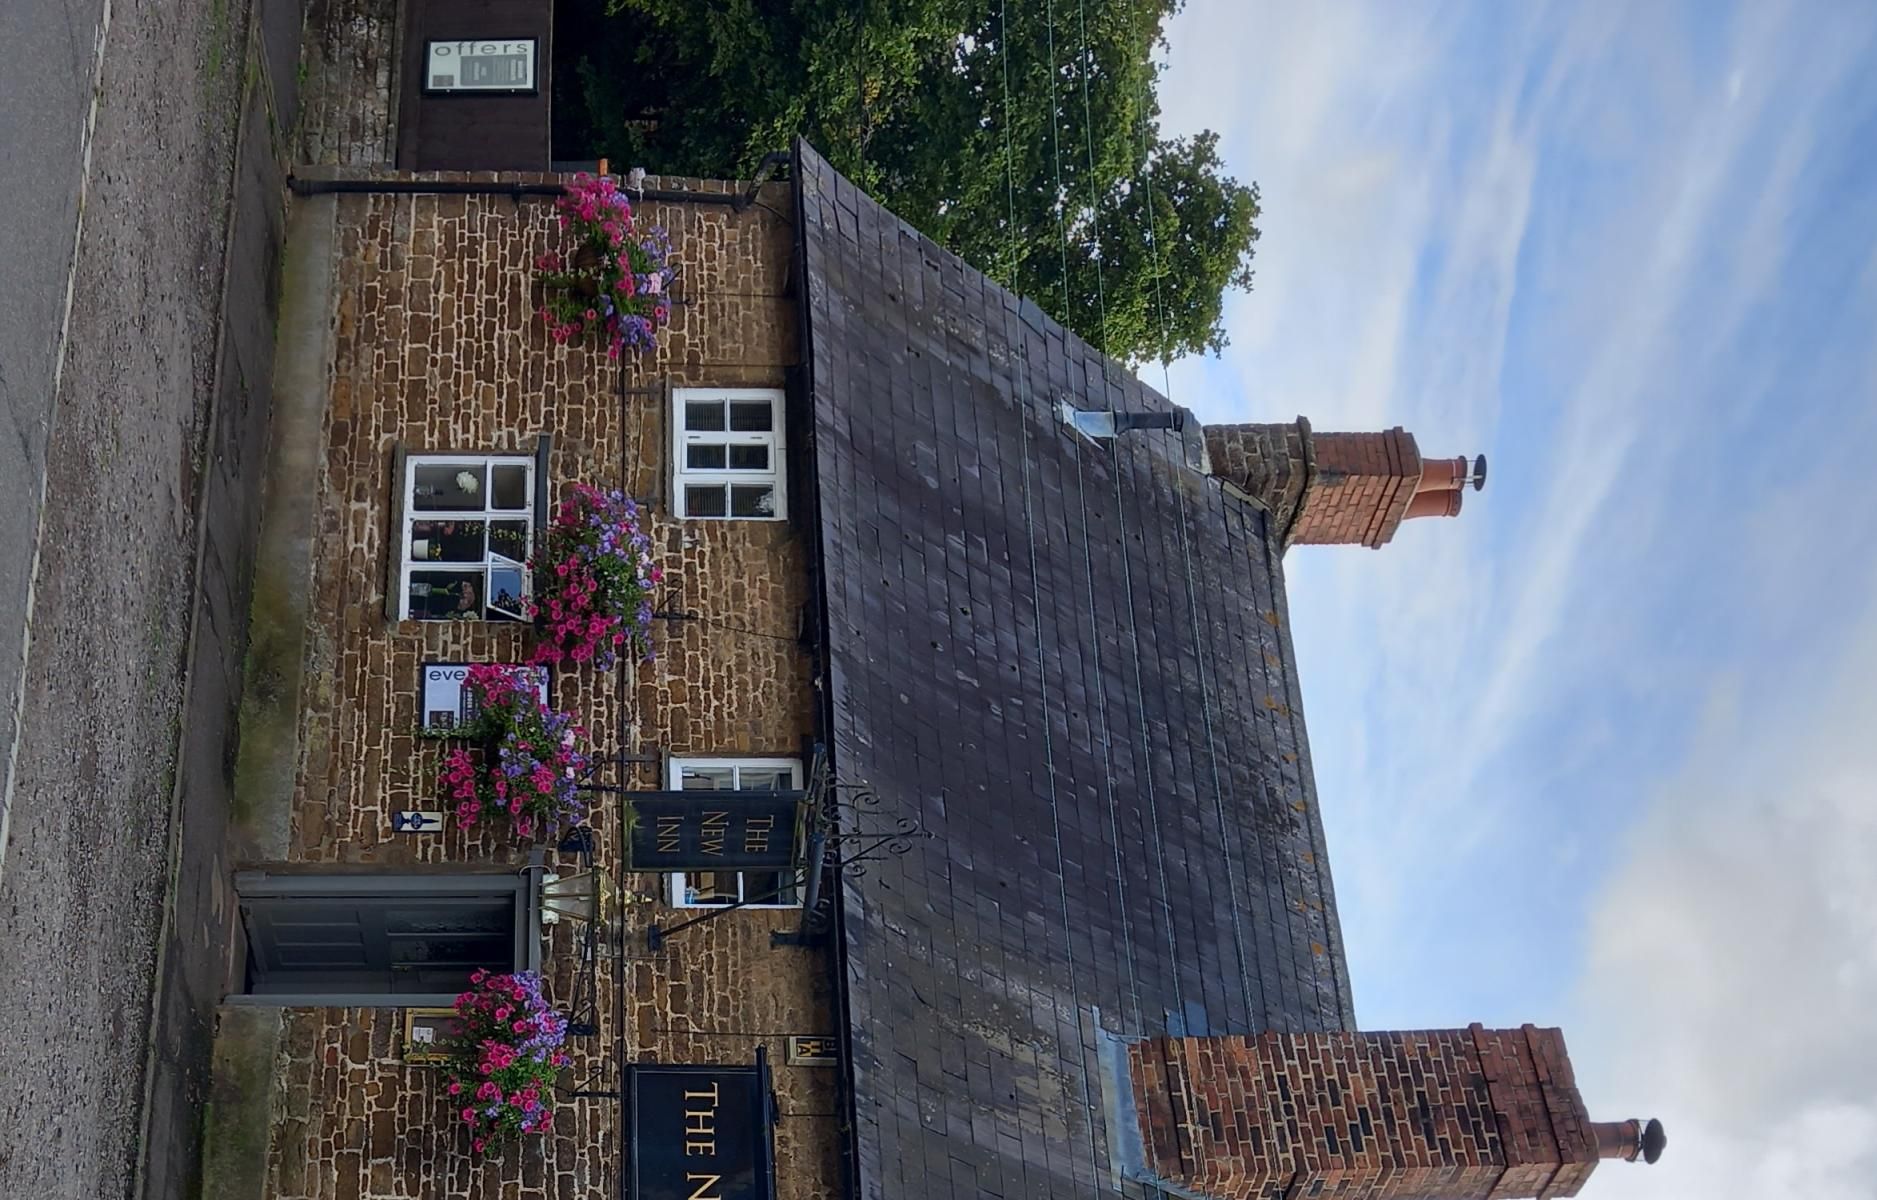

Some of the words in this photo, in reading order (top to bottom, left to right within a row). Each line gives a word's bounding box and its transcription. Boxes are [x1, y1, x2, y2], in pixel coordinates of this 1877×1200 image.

[435, 42, 527, 57] offers
[656, 816, 685, 853] INN
[700, 810, 730, 856] NEW
[744, 814, 774, 853] THE
[684, 1081, 719, 1157] THE
